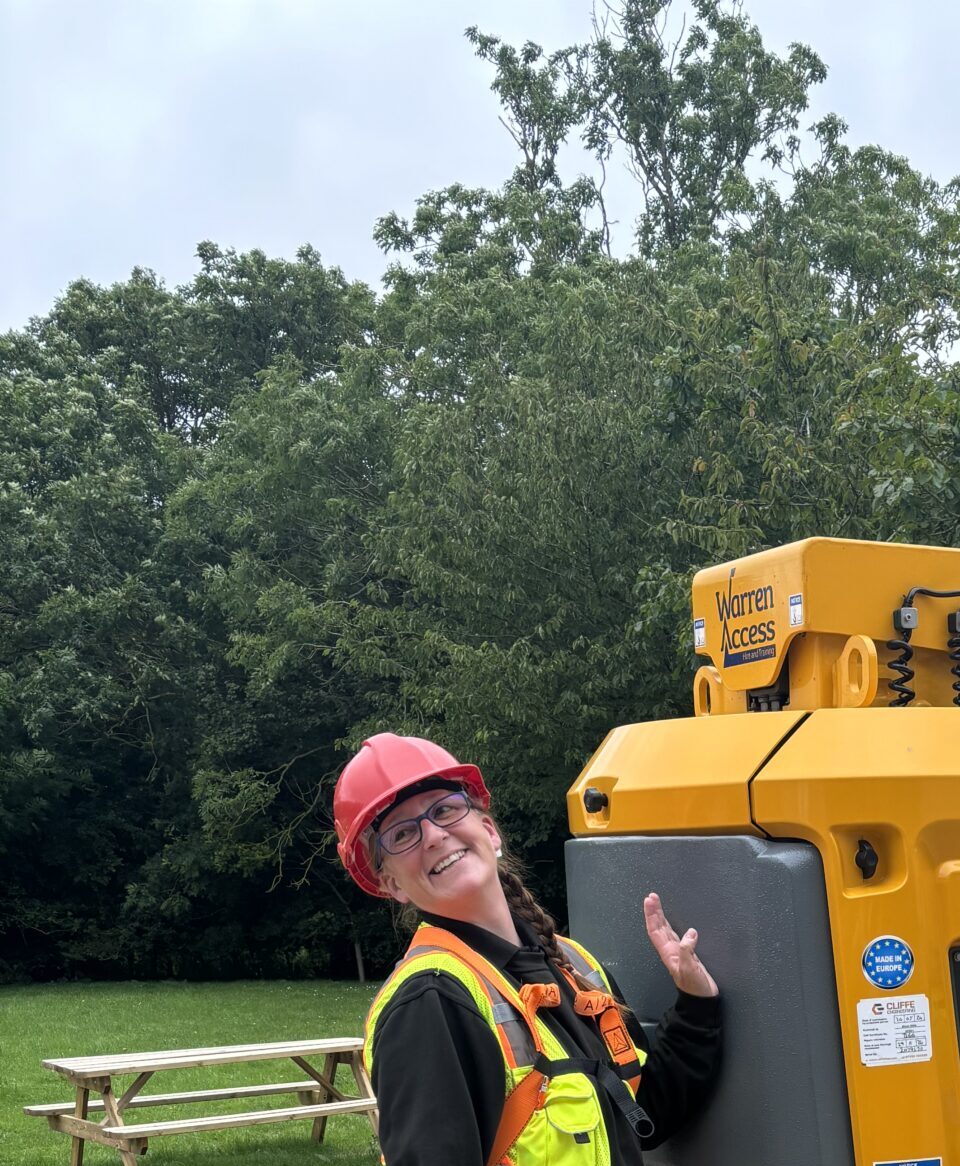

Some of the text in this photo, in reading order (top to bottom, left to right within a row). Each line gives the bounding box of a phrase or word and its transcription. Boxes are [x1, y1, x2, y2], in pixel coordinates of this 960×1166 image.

[716, 577, 774, 622] Warren
[721, 617, 775, 652] Access
[875, 955, 894, 963] MADE
[876, 964, 902, 972] EUROPE
[886, 1001, 915, 1010] CLIFFE
